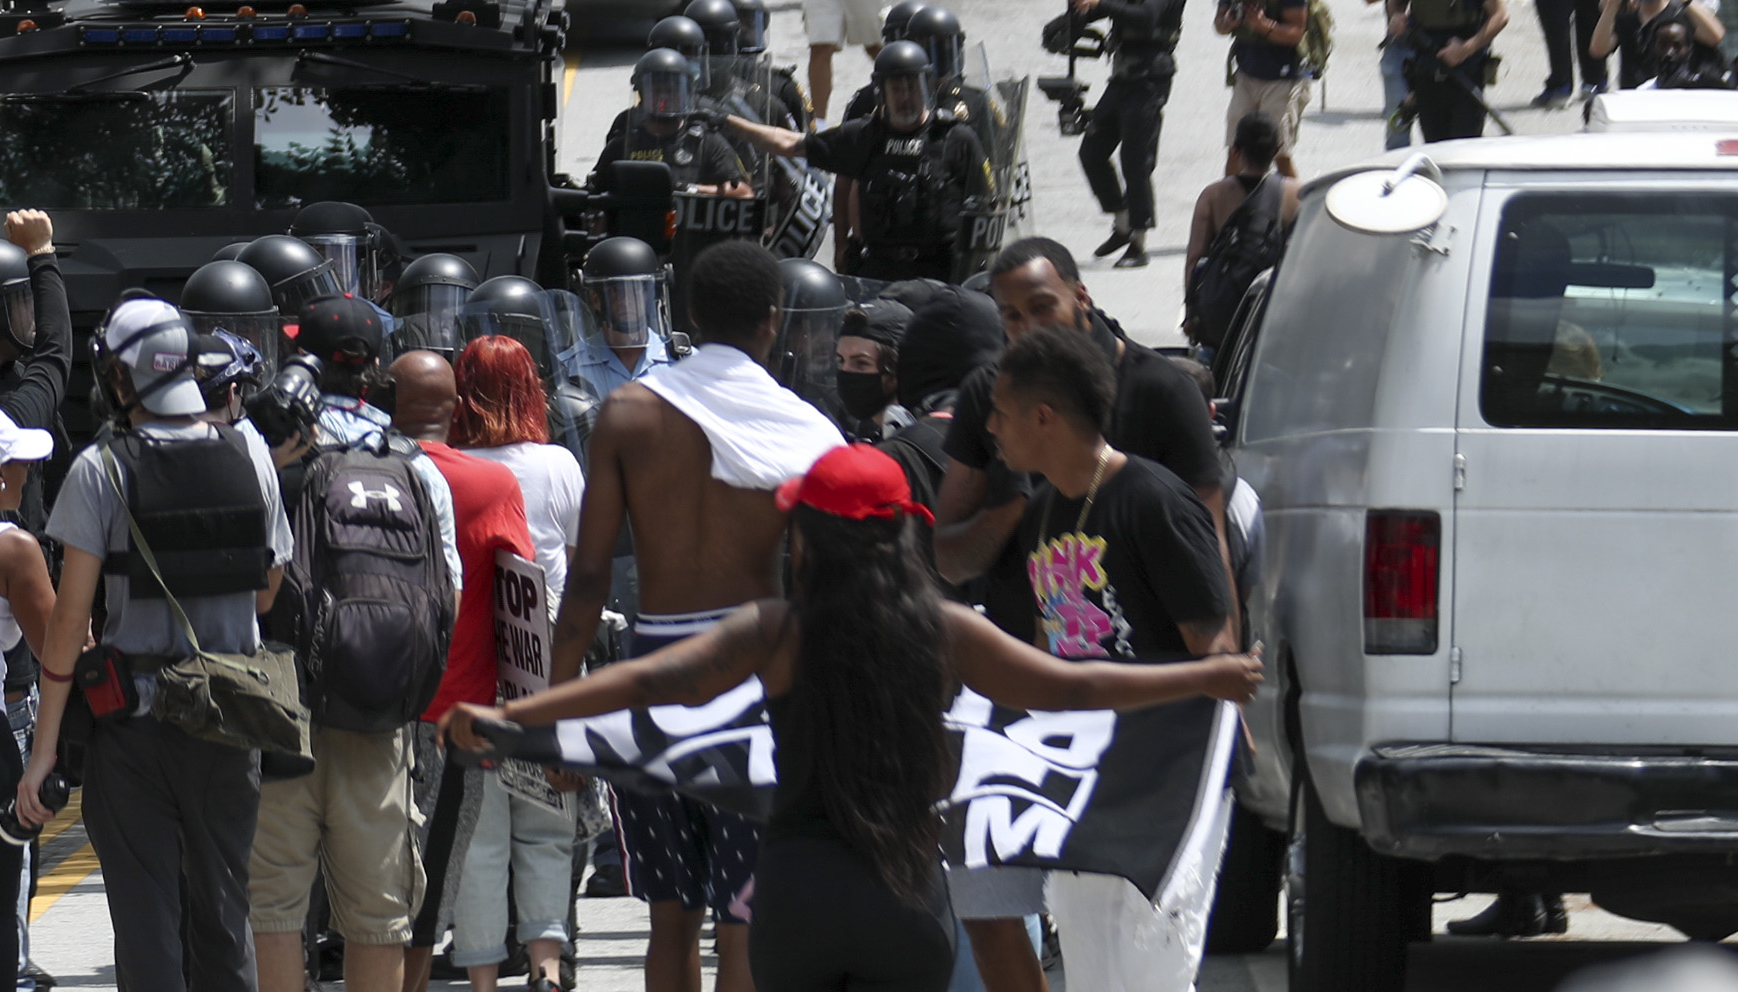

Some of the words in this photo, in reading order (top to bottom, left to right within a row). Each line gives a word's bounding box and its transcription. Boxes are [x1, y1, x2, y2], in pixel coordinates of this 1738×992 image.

[630, 149, 664, 161] POLICE
[885, 138, 925, 156] POLICE
[672, 197, 757, 233] OLICE
[777, 173, 826, 257] OLICE
[495, 564, 538, 623] TOP
[496, 617, 512, 665] HE
[509, 622, 545, 679] WAR
